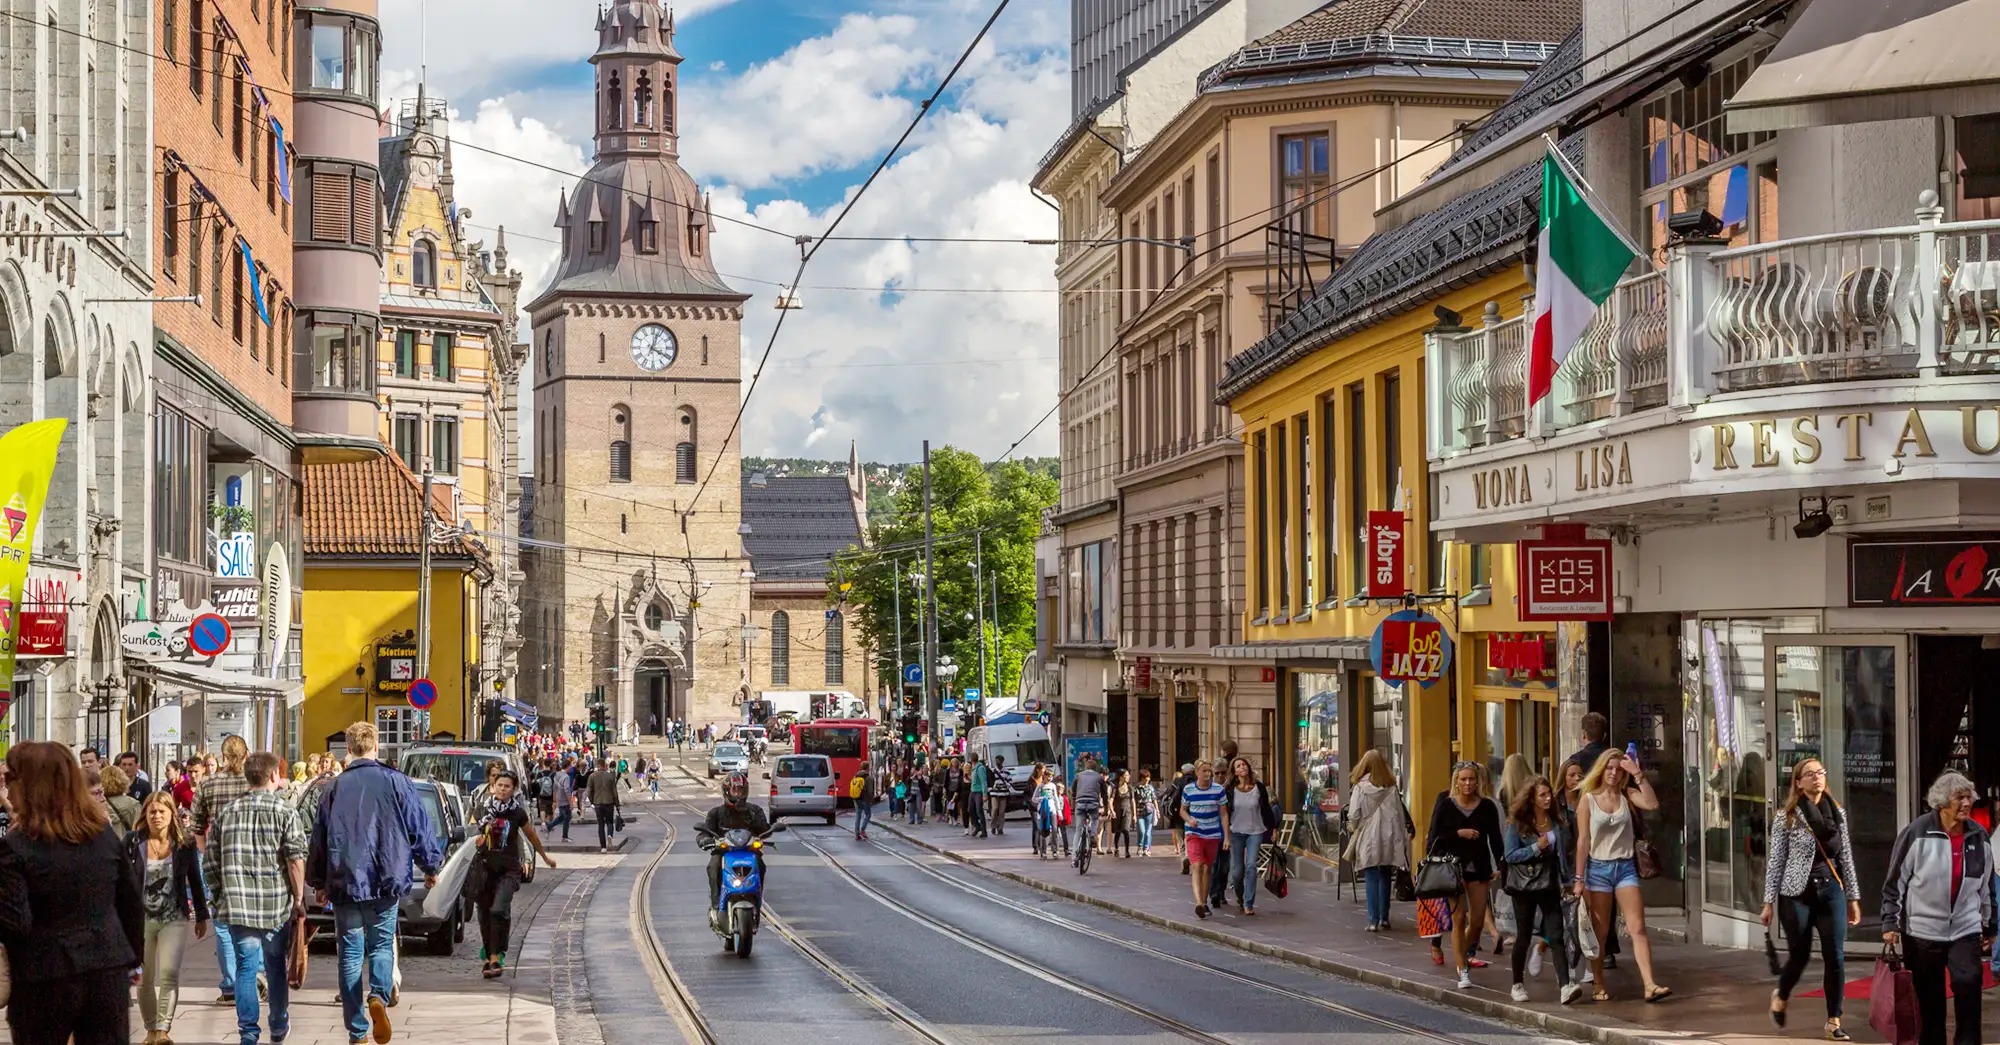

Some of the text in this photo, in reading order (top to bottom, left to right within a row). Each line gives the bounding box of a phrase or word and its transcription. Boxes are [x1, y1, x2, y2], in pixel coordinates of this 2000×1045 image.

[1712, 407, 2000, 470] RESTAU
[1472, 441, 1633, 509] MONA LISA
[1575, 605, 1597, 613] Lounge
[121, 634, 168, 647] Sunkost
[1389, 652, 1440, 678] JAZZ
[1040, 715, 1049, 724] N
